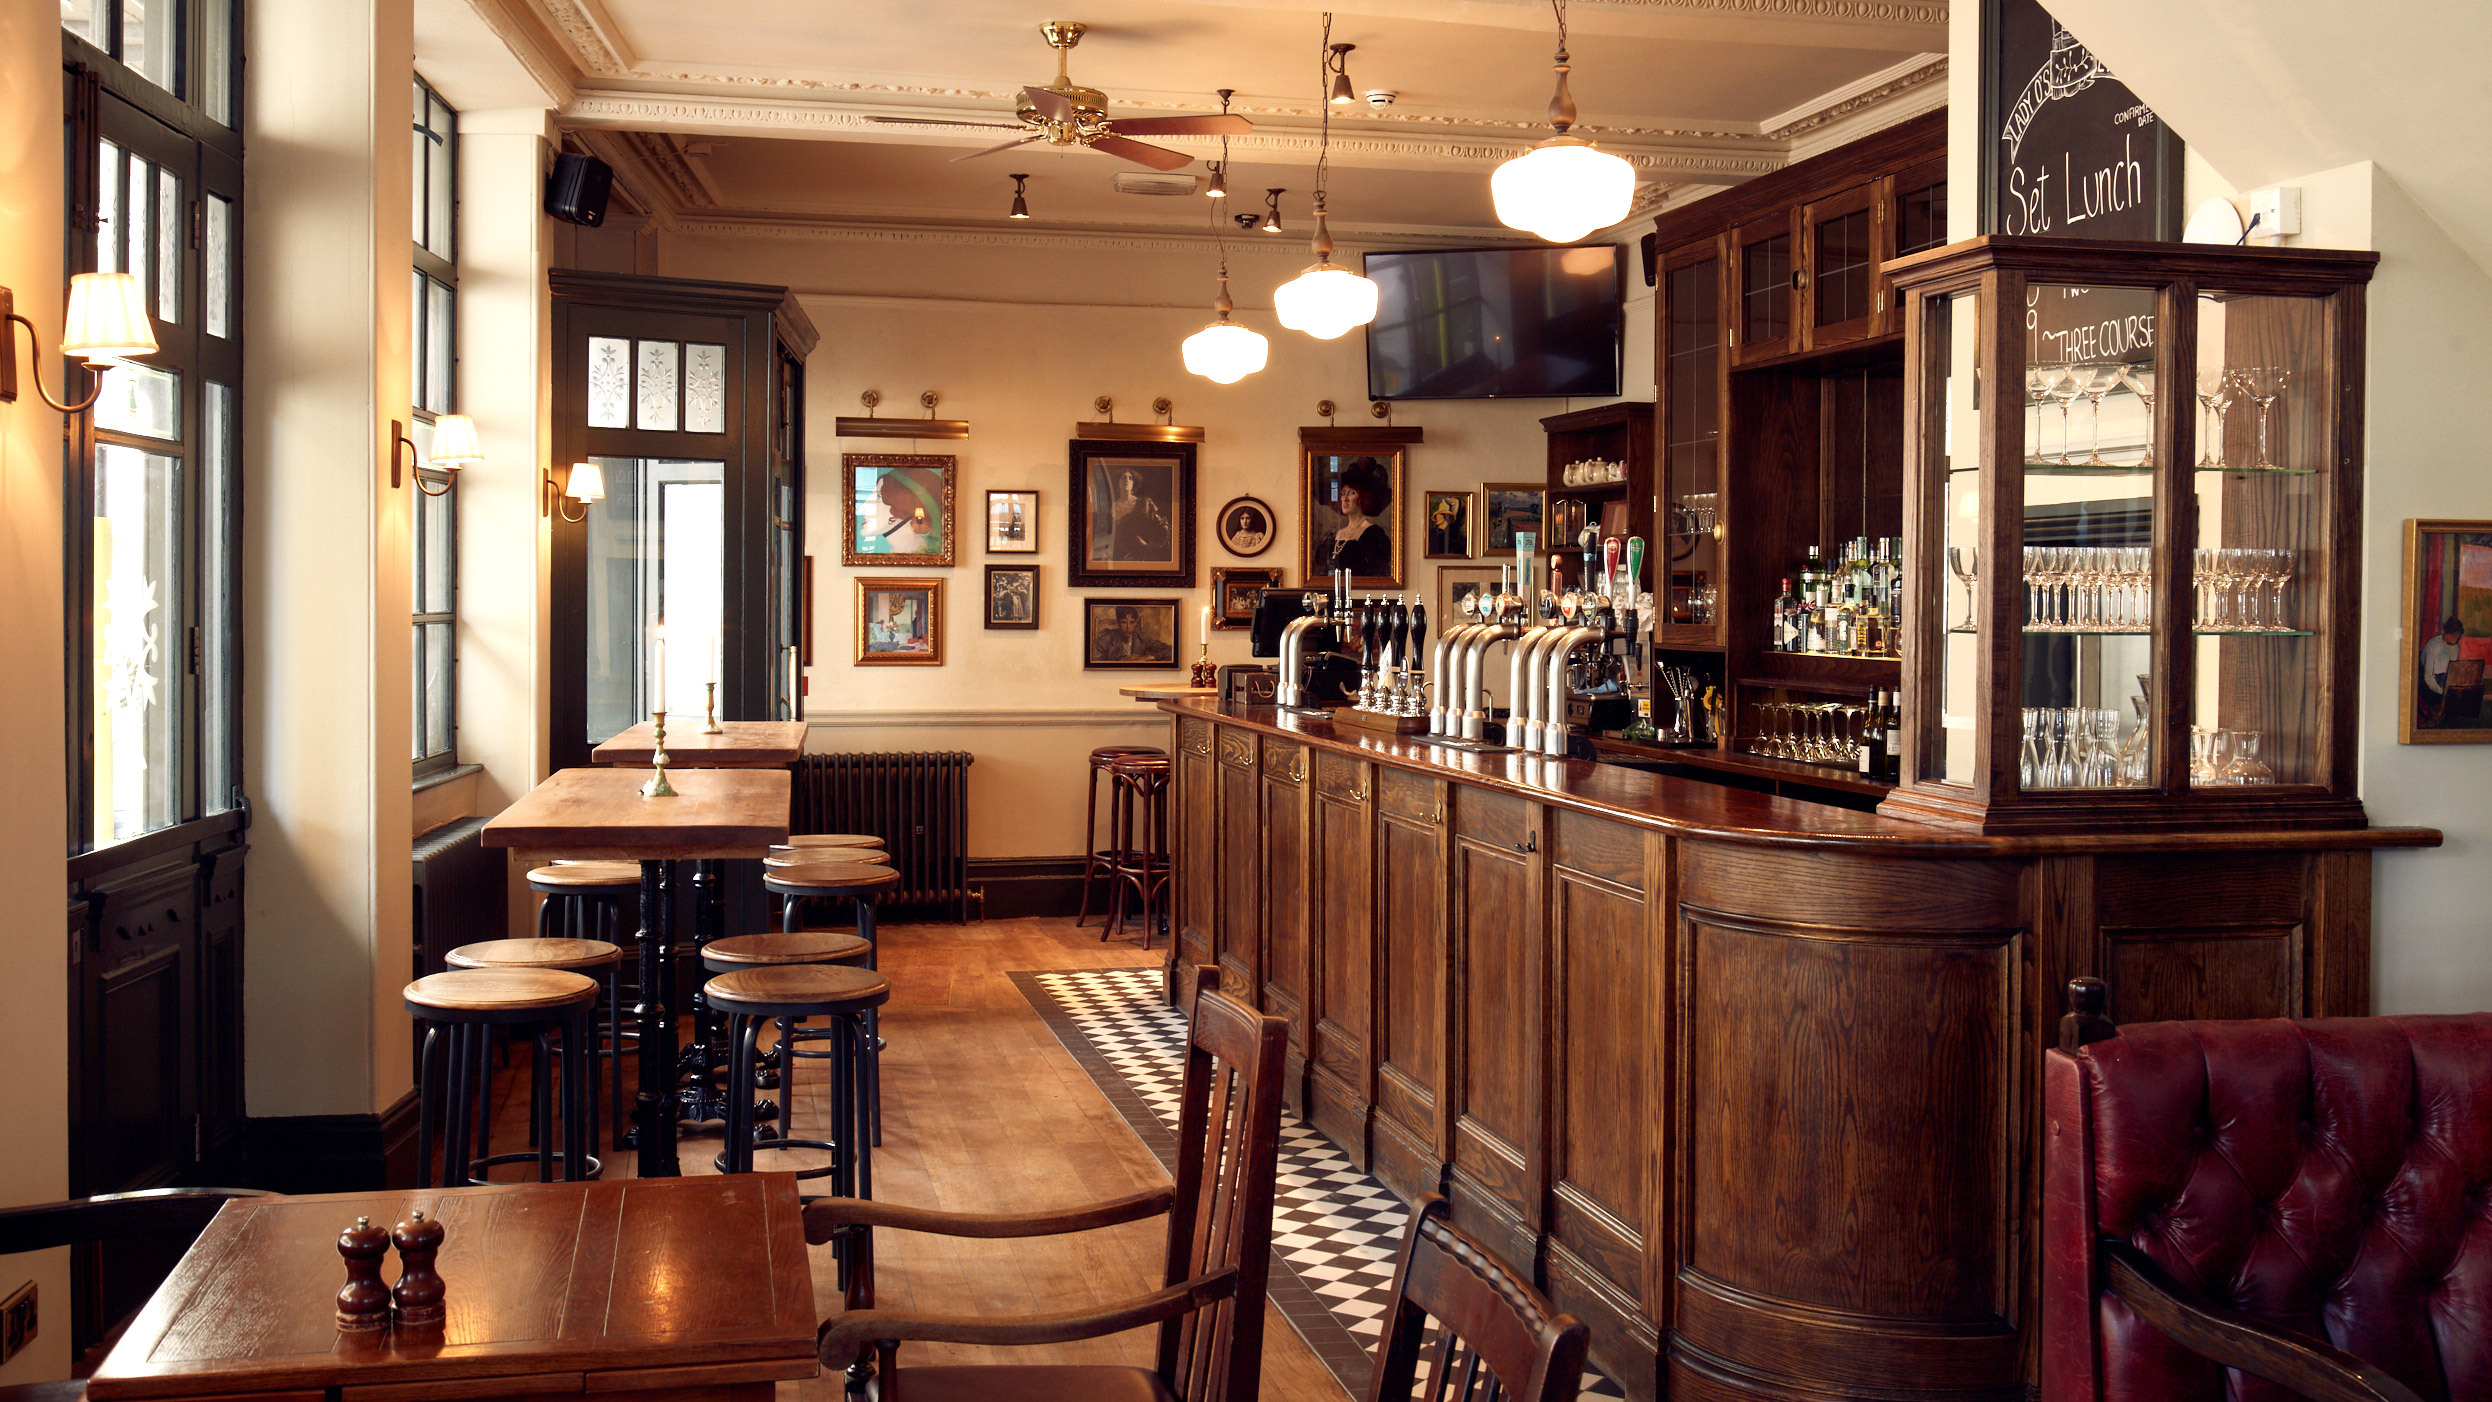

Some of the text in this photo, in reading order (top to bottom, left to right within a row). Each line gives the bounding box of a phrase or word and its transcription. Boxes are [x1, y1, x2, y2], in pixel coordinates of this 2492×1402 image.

[2009, 69, 2050, 142] LADY O'S
[2137, 112, 2154, 128] DATE
[2007, 133, 2141, 236] Set Lunch
